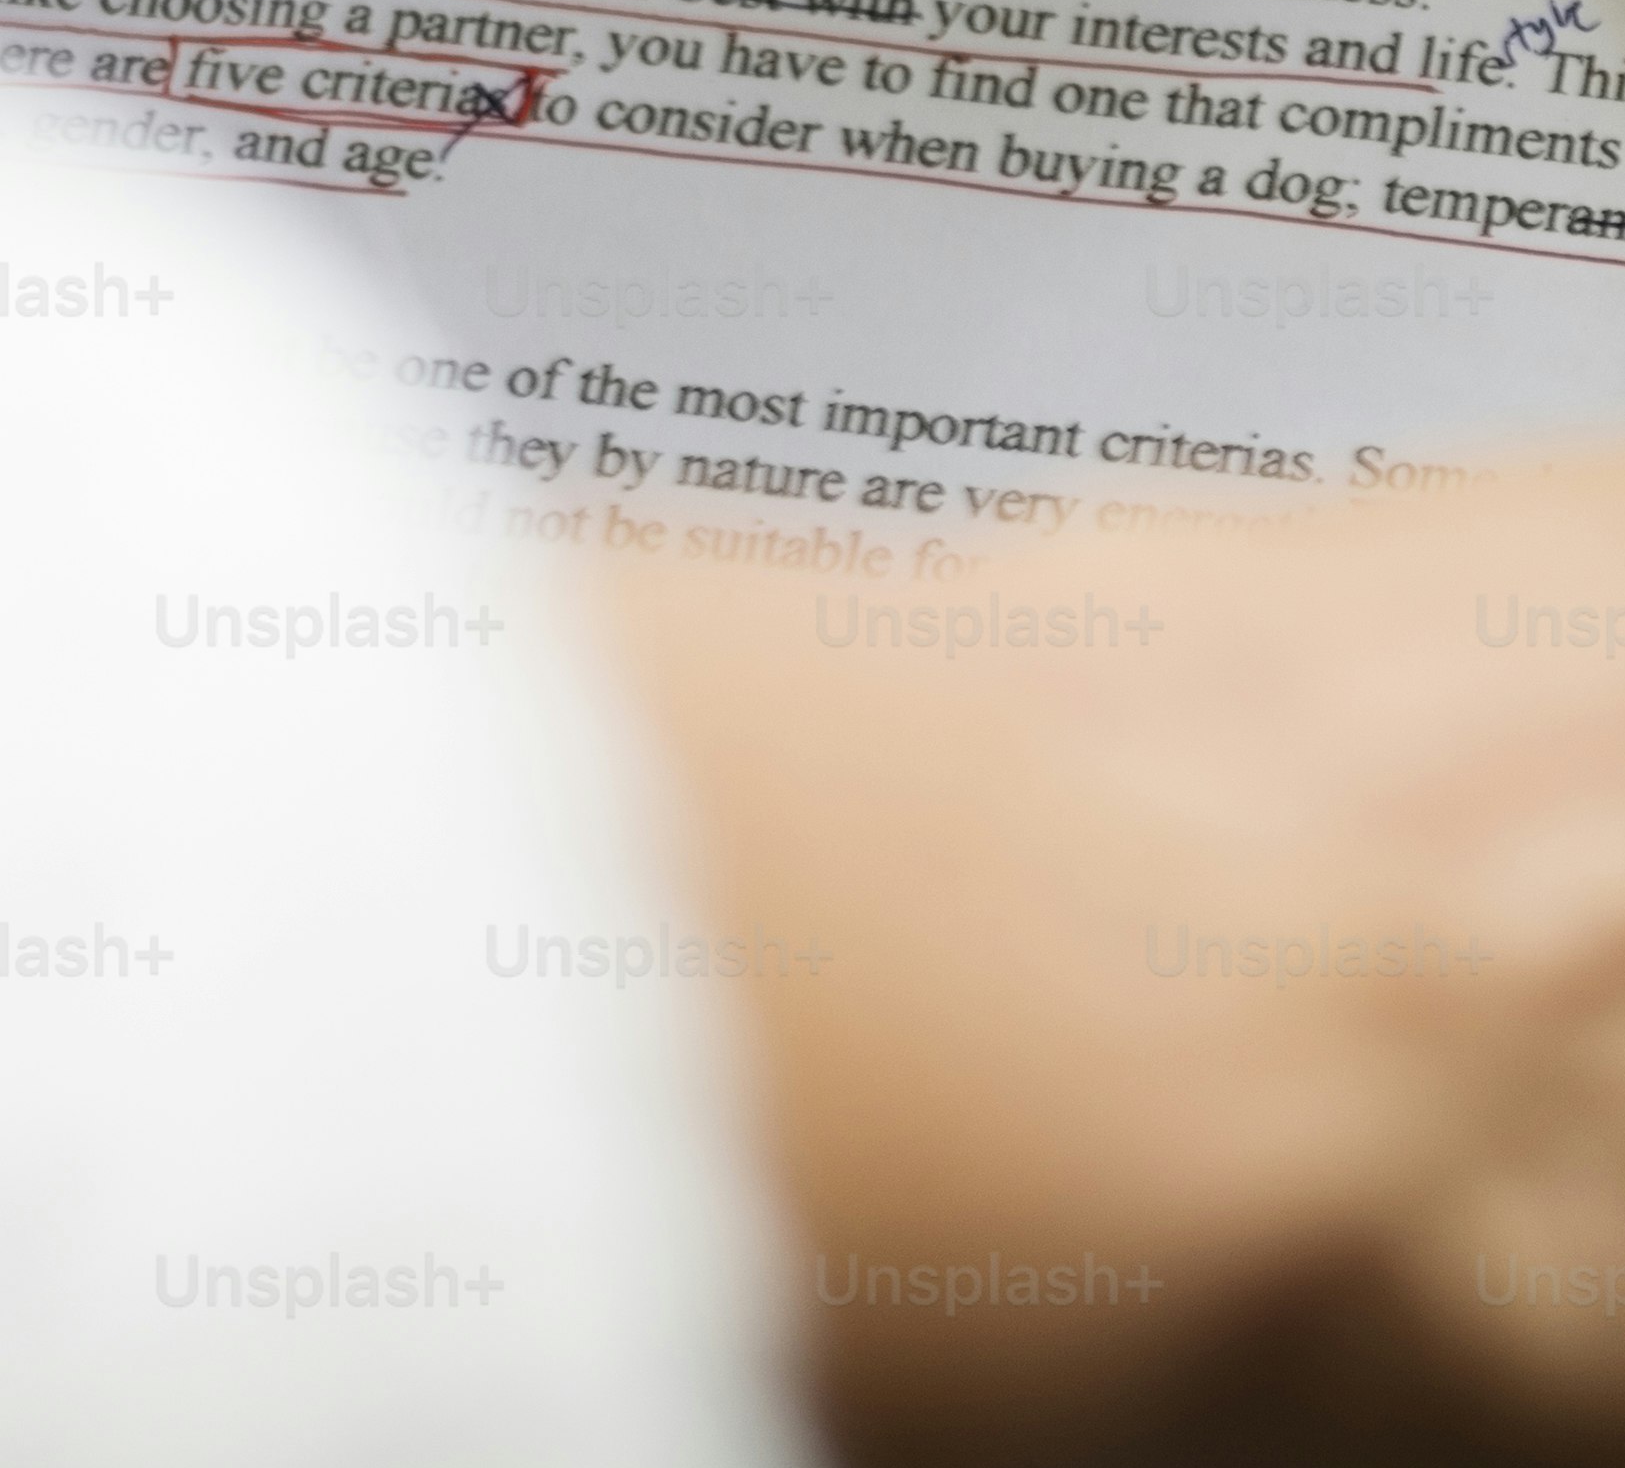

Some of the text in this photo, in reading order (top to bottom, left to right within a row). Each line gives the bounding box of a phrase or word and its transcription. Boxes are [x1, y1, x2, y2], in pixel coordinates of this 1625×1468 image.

[387, 3, 588, 65] partner,
[929, 53, 1038, 111] find
[1279, 92, 1623, 172] compliments
[1070, 3, 1290, 69] interests
[184, 46, 285, 96] five
[595, 88, 816, 155] consider
[841, 117, 981, 178] when
[999, 135, 1183, 205] buying
[1245, 159, 1361, 219] dog;
[465, 419, 580, 483] they
[595, 428, 659, 491] by
[674, 449, 848, 505] nature
[962, 474, 1080, 531] very
[674, 374, 809, 428] most
[822, 385, 1085, 463] important
[1099, 421, 1326, 486] criterias.
